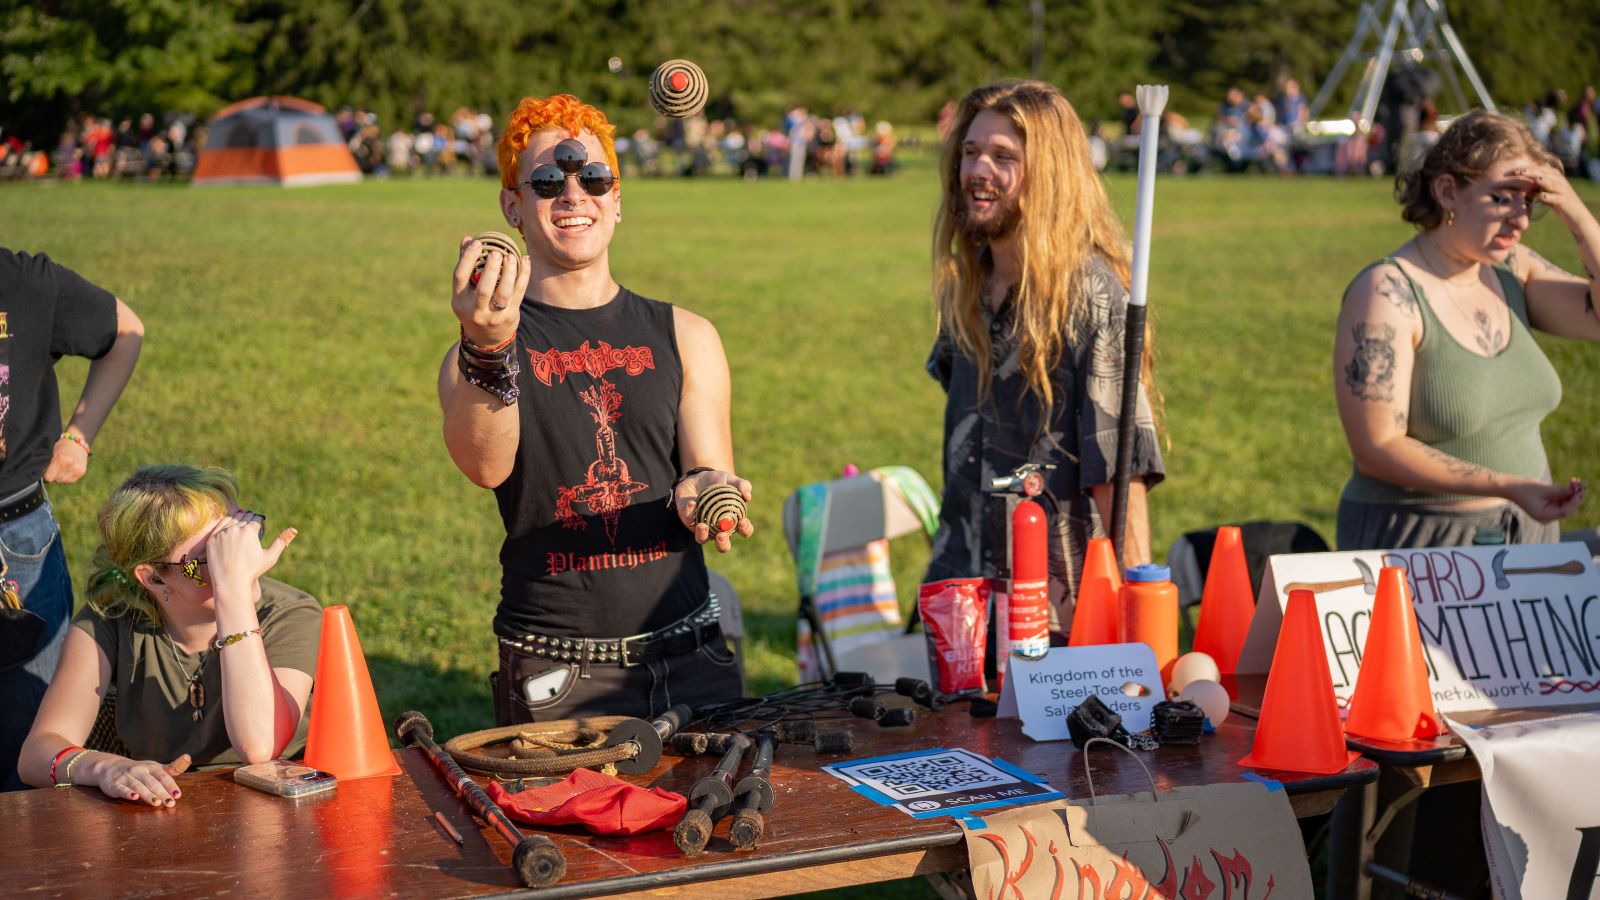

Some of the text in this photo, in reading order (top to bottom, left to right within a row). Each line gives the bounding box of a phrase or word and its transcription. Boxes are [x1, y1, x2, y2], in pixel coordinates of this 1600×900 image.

[546, 540, 668, 576] Plantichrist
[957, 660, 980, 673] KIT
[1029, 666, 1144, 685] Kingdom of the
[1044, 700, 1141, 718] Saladers
[945, 788, 1028, 805] SCAN ME
